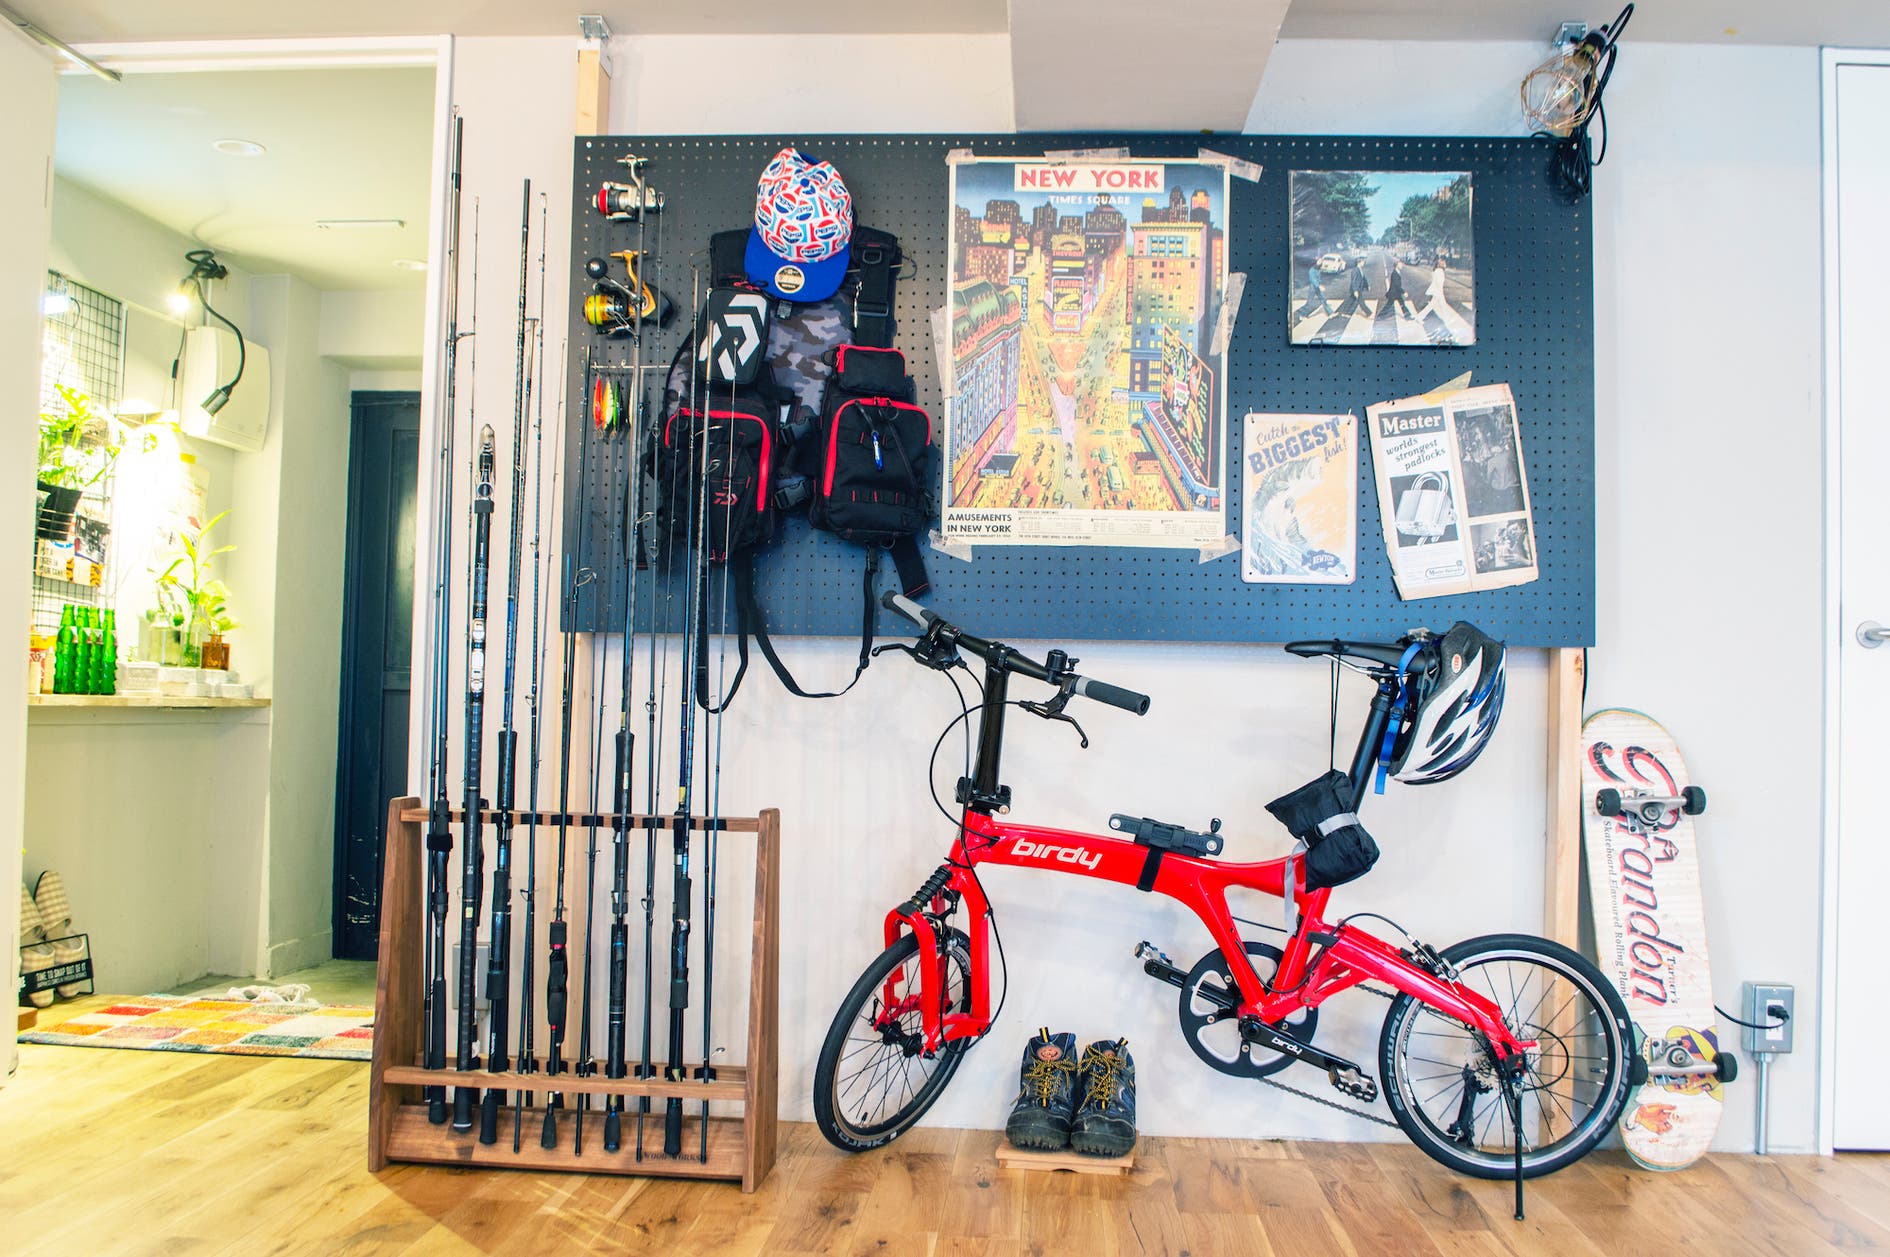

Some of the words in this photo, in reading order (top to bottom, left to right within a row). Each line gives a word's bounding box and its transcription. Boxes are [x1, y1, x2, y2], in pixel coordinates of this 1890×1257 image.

[1020, 169, 1078, 188] NEW
[1091, 169, 1161, 188] YORK
[776, 194, 796, 212] PEPSI
[1048, 195, 1083, 205] TIMES
[1086, 195, 1131, 205] SQUARE
[781, 227, 803, 238] PEPSI
[815, 225, 838, 235] PEPSI
[1256, 422, 1289, 446] Catch
[1381, 414, 1442, 436] Master
[1247, 416, 1341, 476] BIGGEST
[1323, 438, 1349, 464] fish!
[1385, 437, 1419, 456] worlds
[1395, 439, 1438, 462] strongest
[1404, 448, 1447, 472] padlocks
[947, 513, 1013, 522] AMUSEMENTS
[947, 524, 958, 532] IN
[960, 524, 983, 533] NEW
[985, 524, 1012, 533] YORK
[1010, 838, 1103, 870] birdy
[1603, 820, 1617, 876] Skateboard
[1608, 878, 1623, 928] Flavoured
[1614, 931, 1626, 967] Rolling
[1618, 970, 1630, 999] Plank
[1666, 955, 1681, 1004] Turner's
[1271, 1036, 1303, 1056] birdy
[1386, 995, 1414, 1112] SCHWALB
[1592, 1036, 1631, 1140] KOJAK
[831, 1121, 886, 1148] KOJAK
